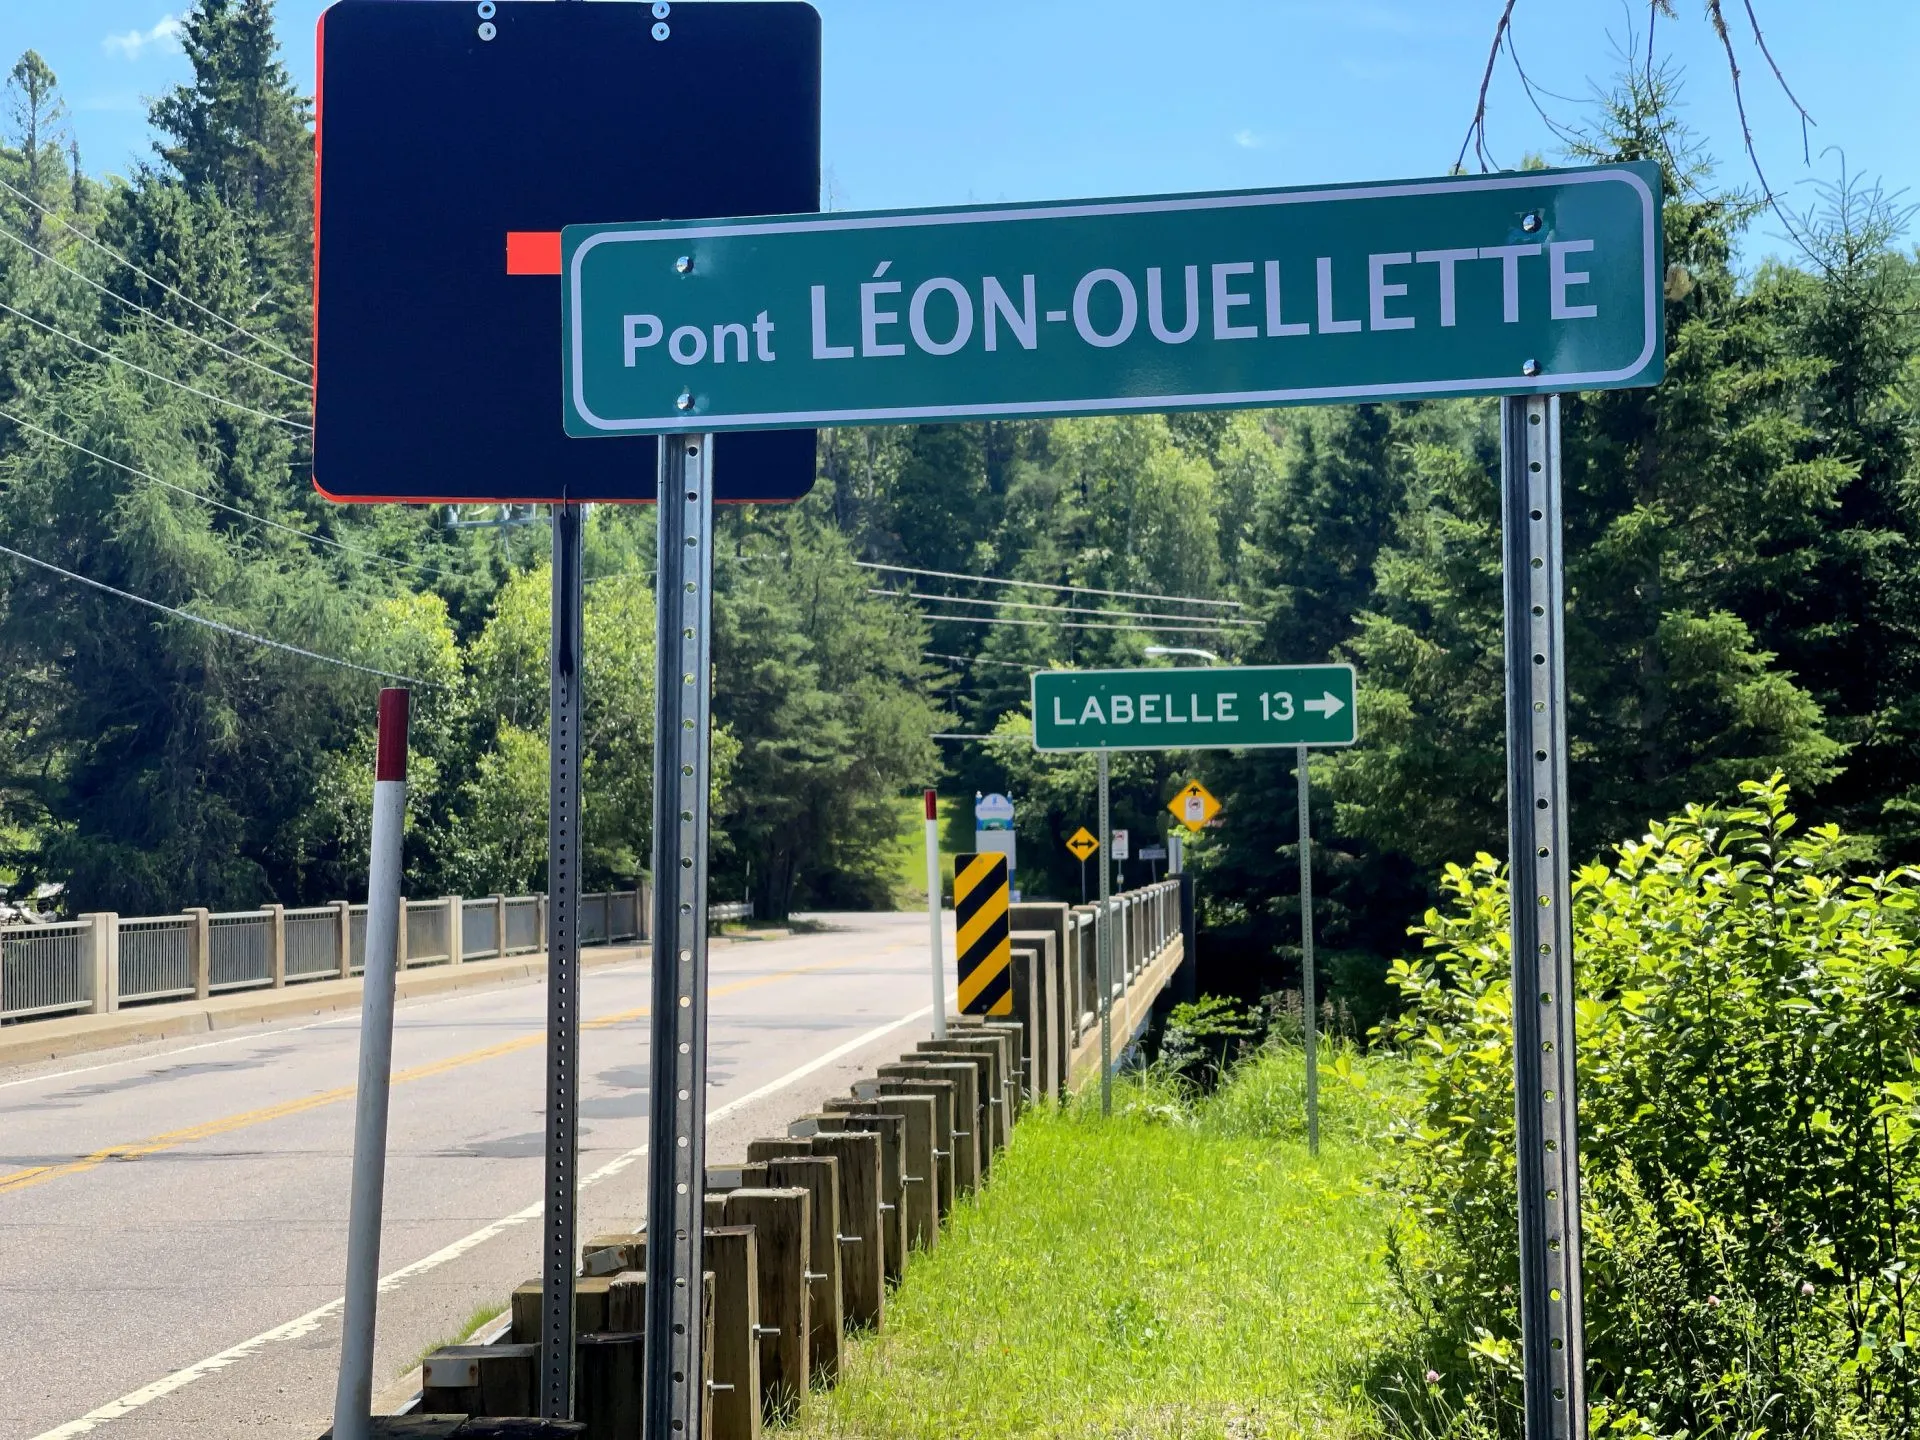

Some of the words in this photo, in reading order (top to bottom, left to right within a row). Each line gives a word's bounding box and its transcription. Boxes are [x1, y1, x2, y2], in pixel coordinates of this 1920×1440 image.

[623, 309, 775, 367] Pont
[810, 239, 1598, 359] LÉON-OUELLETTE
[1053, 692, 1239, 725] LABELLE
[1259, 691, 1295, 721] 13
